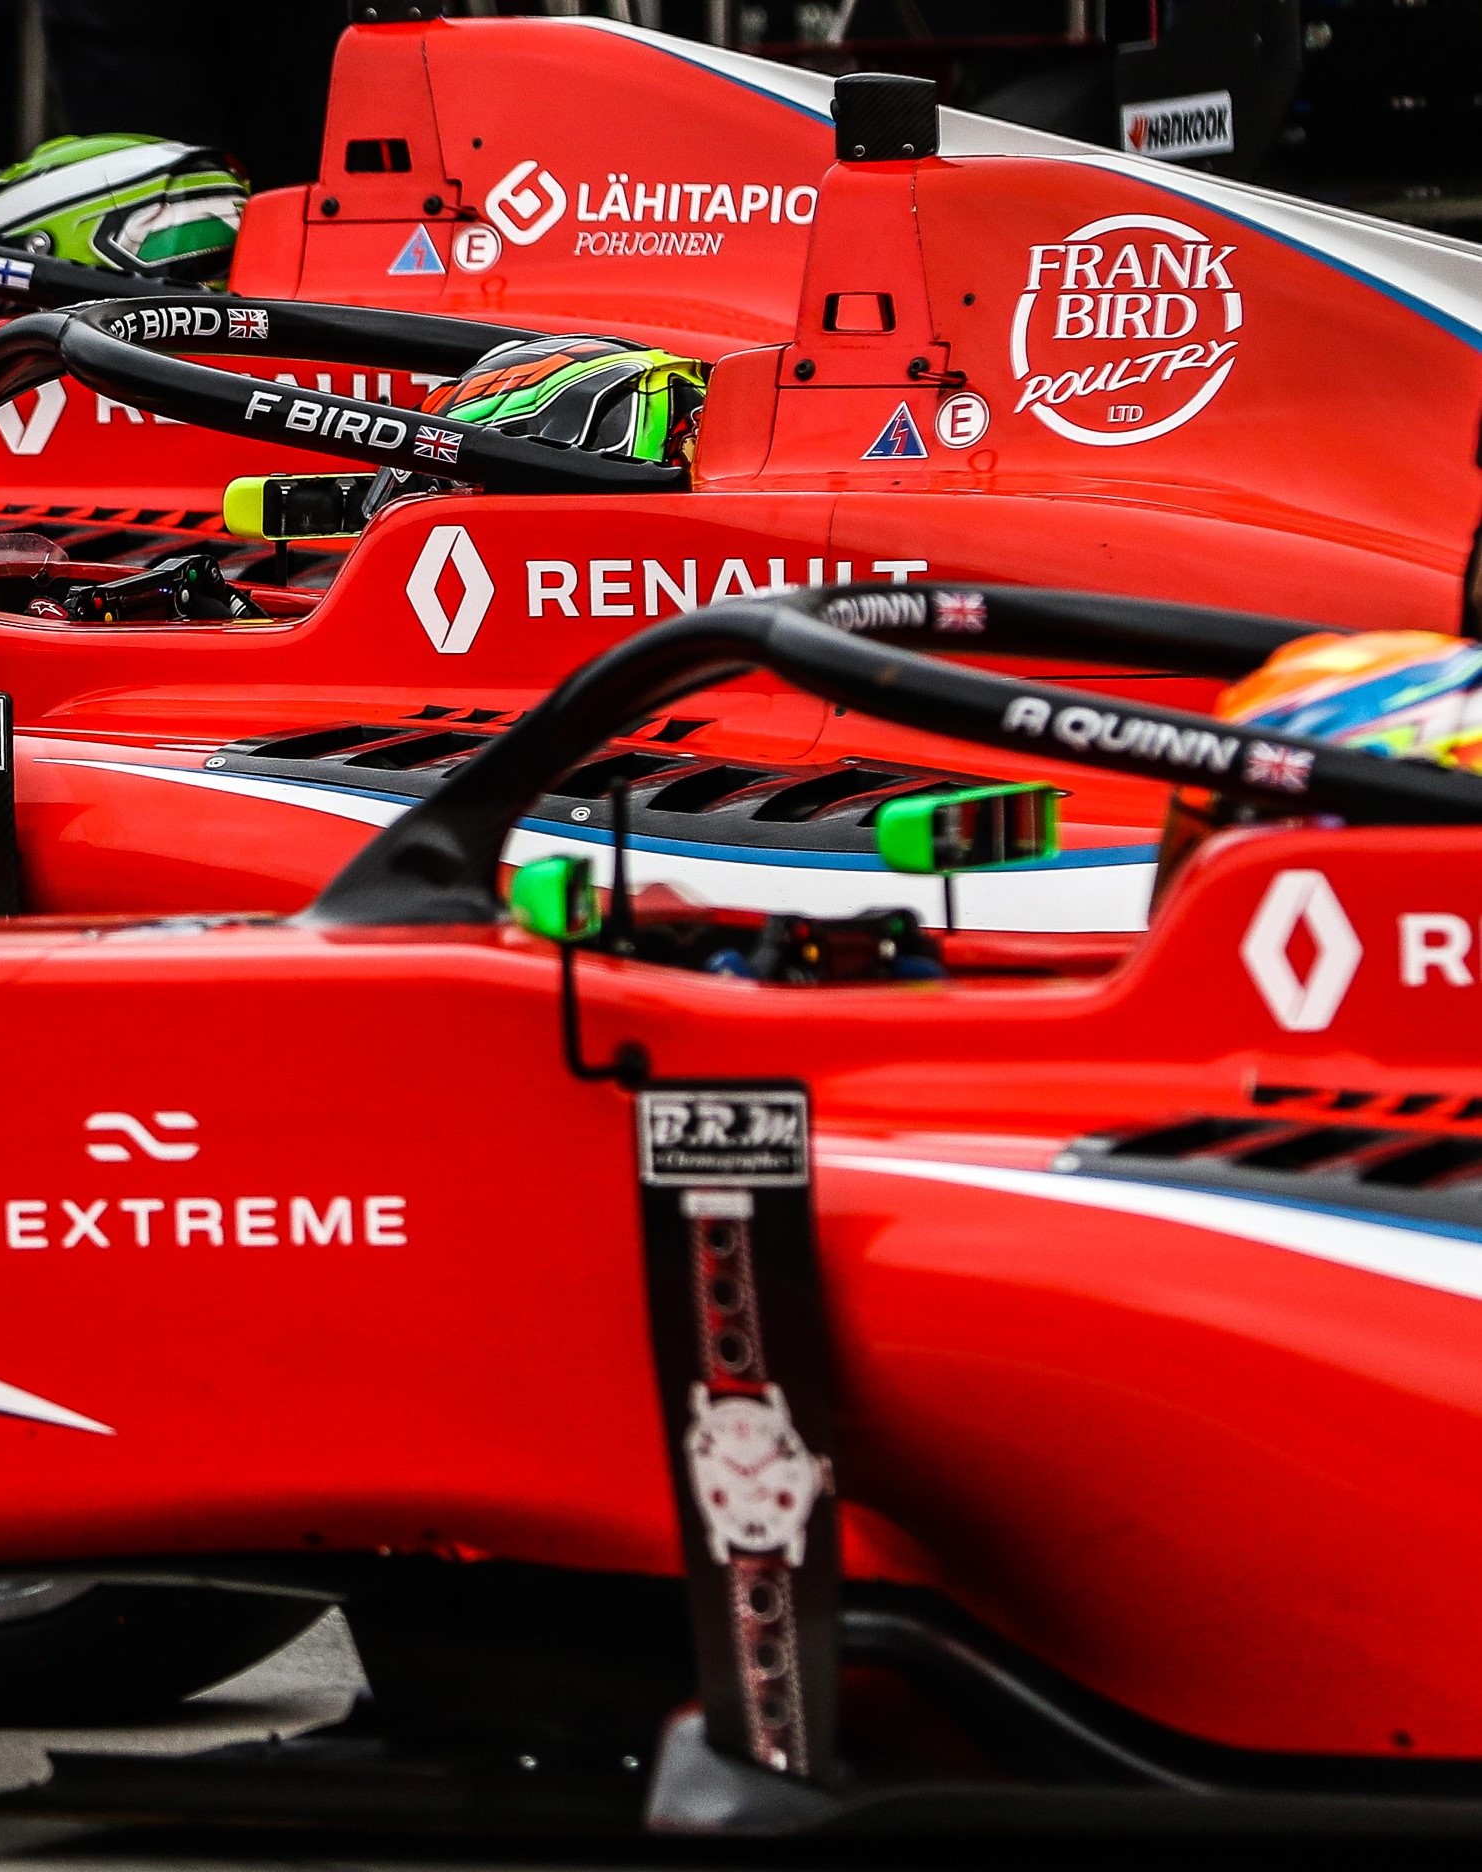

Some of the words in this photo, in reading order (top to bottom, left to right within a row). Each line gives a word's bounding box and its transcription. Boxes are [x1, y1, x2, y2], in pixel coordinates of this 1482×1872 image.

[573, 231, 725, 257] POHJOINEN
[1024, 243, 1237, 290] FRANK
[139, 306, 221, 340] BIRD
[1052, 293, 1198, 340] BIRD
[1013, 339, 1238, 414] POULTRY
[245, 390, 282, 420] F
[286, 399, 408, 449] BIRD
[950, 403, 973, 438] E
[1107, 405, 1144, 422] LTD
[1053, 706, 1240, 773] QUINN
